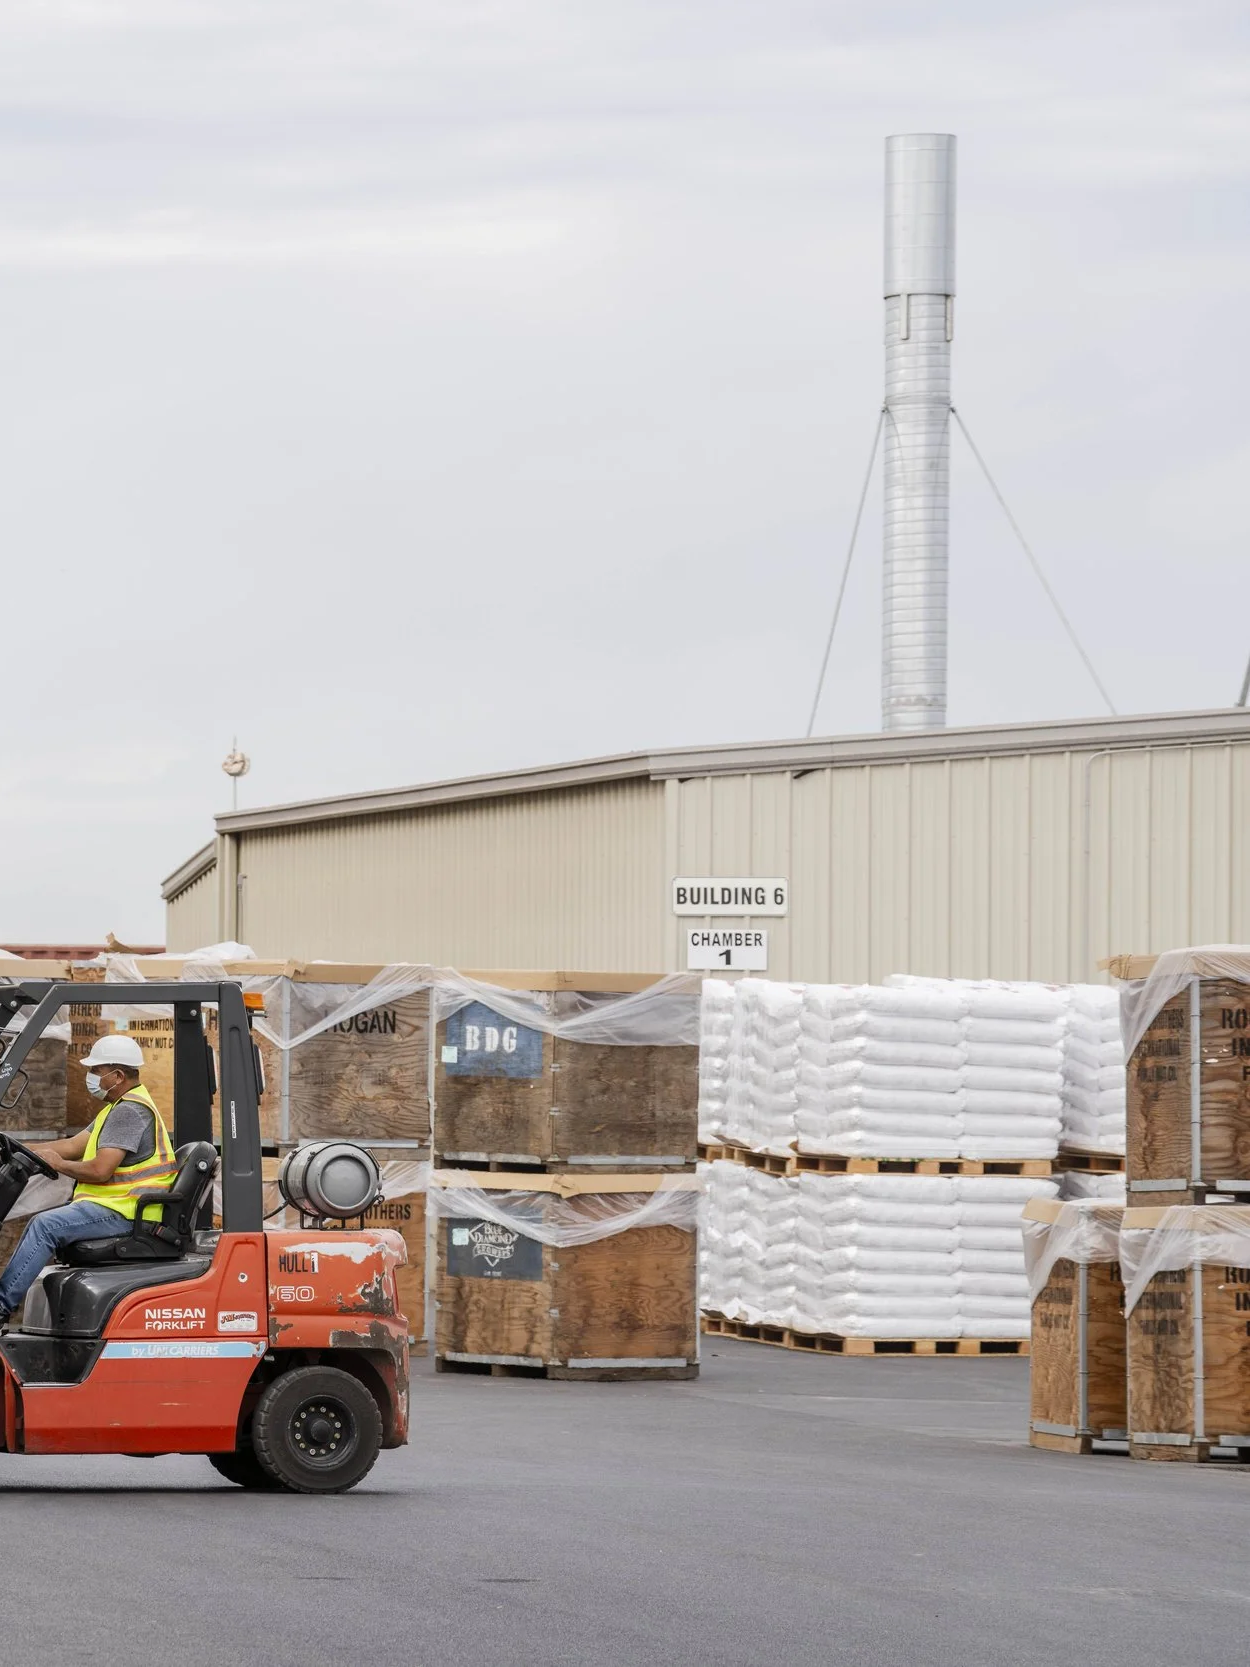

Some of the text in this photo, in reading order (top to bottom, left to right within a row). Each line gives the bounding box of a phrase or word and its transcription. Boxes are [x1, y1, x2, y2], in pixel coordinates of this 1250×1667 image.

[676, 887, 785, 905] BUILDING 6
[691, 932, 763, 947] CHAMBER
[718, 949, 732, 966] 1
[465, 1025, 517, 1054] BDG
[278, 1253, 309, 1274] HULL
[145, 1308, 206, 1319] NISSAN
[145, 1320, 206, 1331] FORKLIFT
[132, 1345, 145, 1358] by
